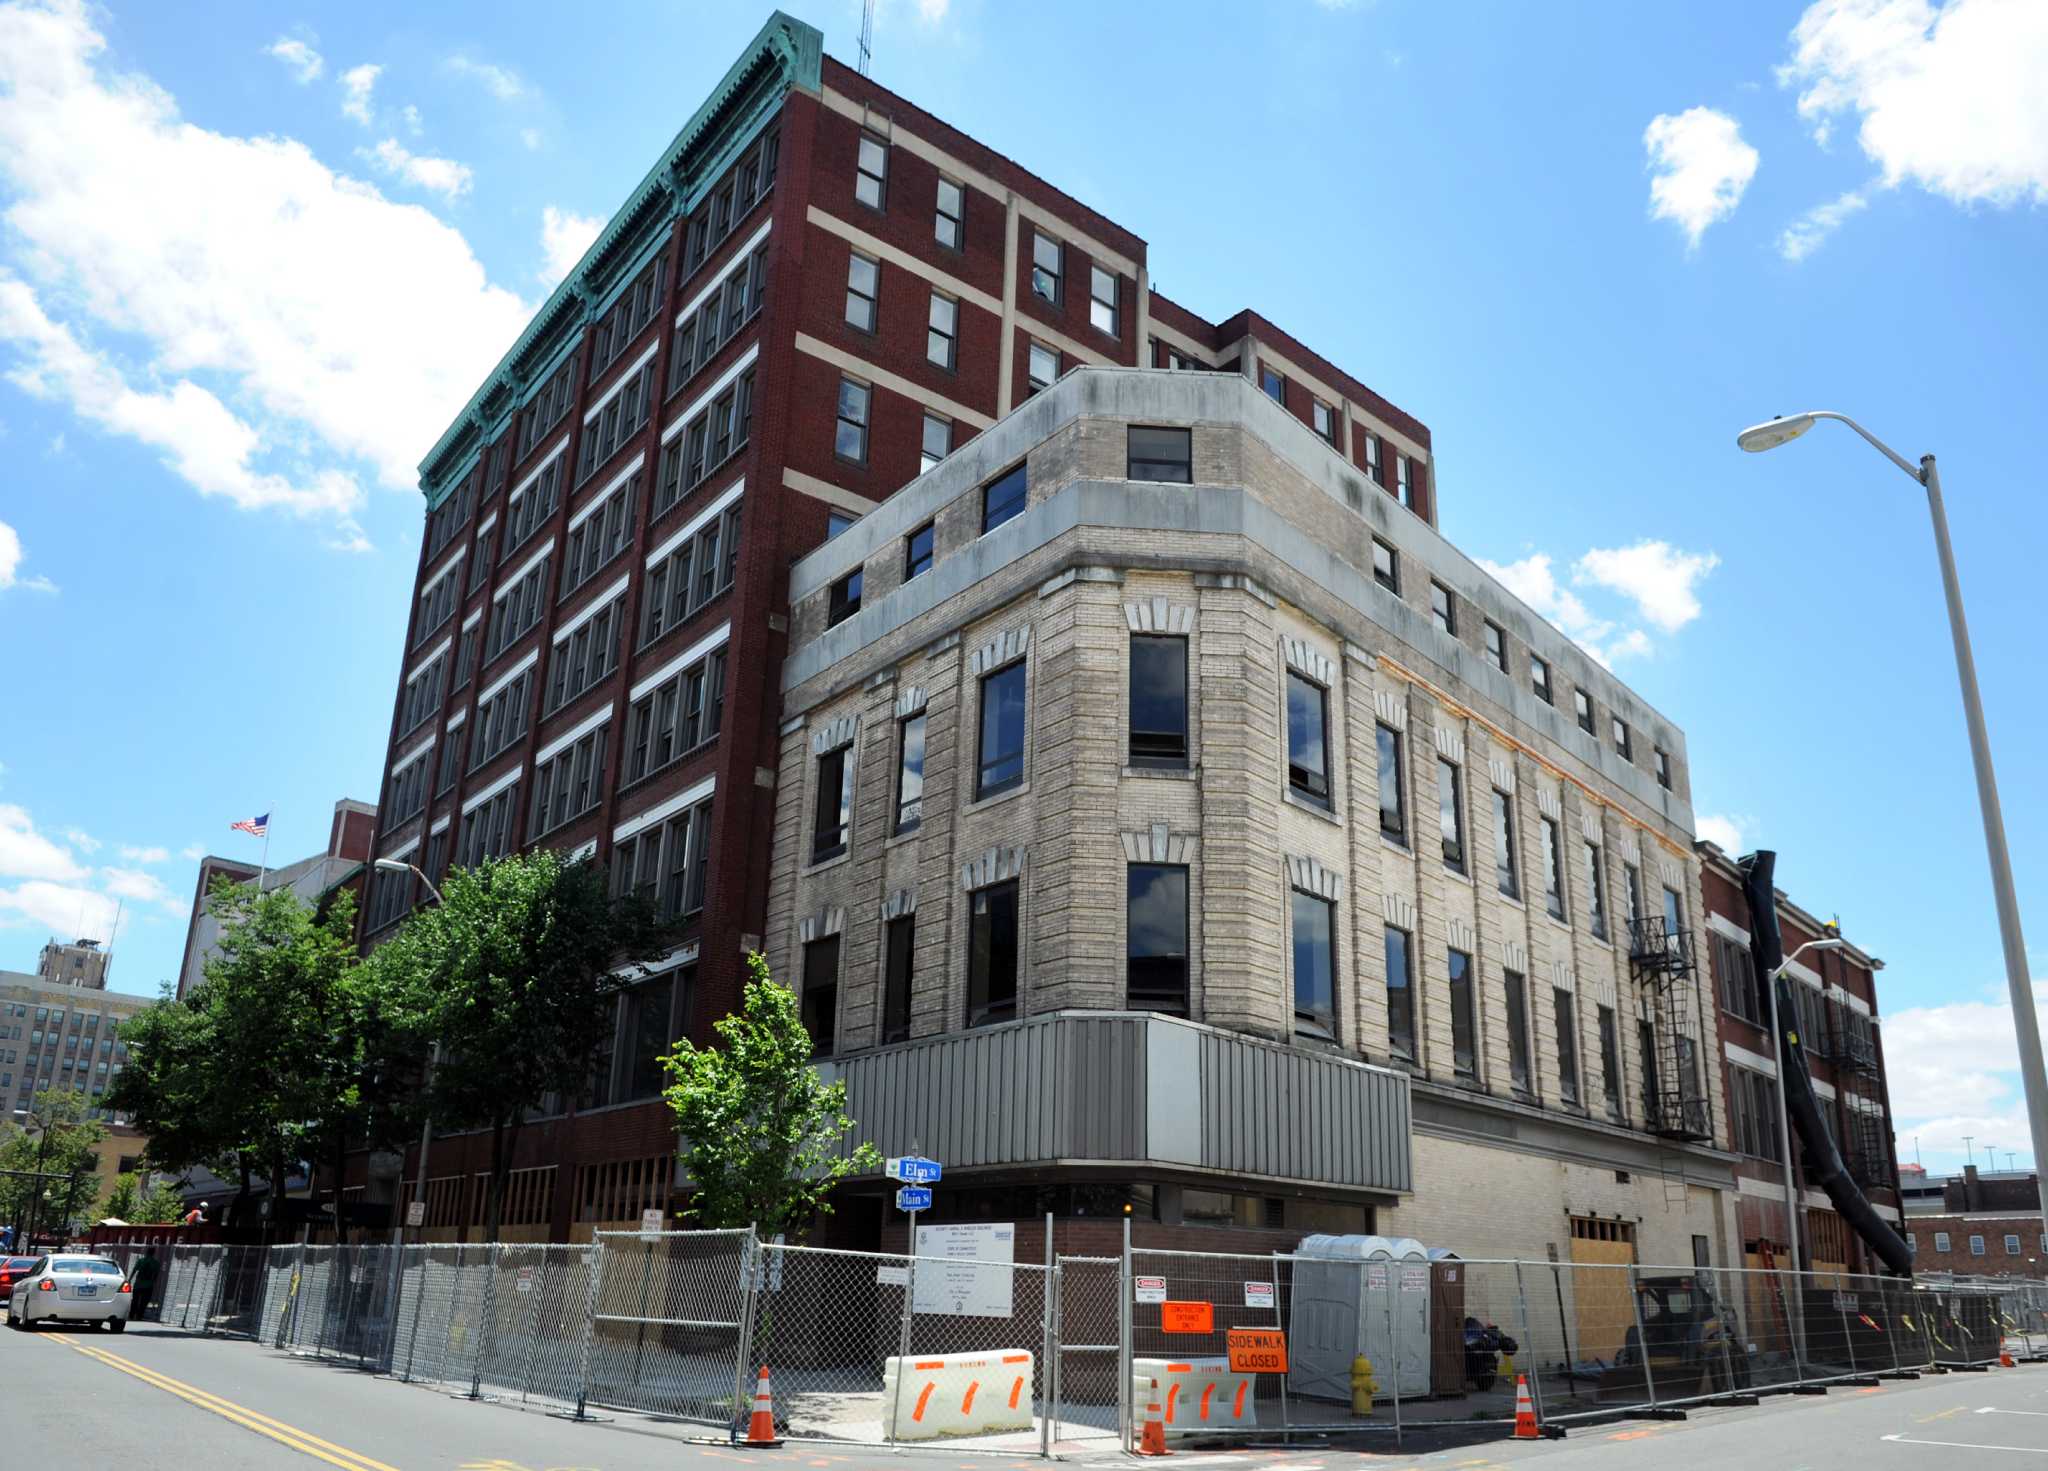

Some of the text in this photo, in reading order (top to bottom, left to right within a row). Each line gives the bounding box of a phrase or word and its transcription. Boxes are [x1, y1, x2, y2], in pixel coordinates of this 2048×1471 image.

[905, 1163, 928, 1177] Elm
[902, 1192, 921, 1205] Main
[1229, 1335, 1284, 1349] SIDEWALK
[1237, 1354, 1279, 1368] CLOSED
